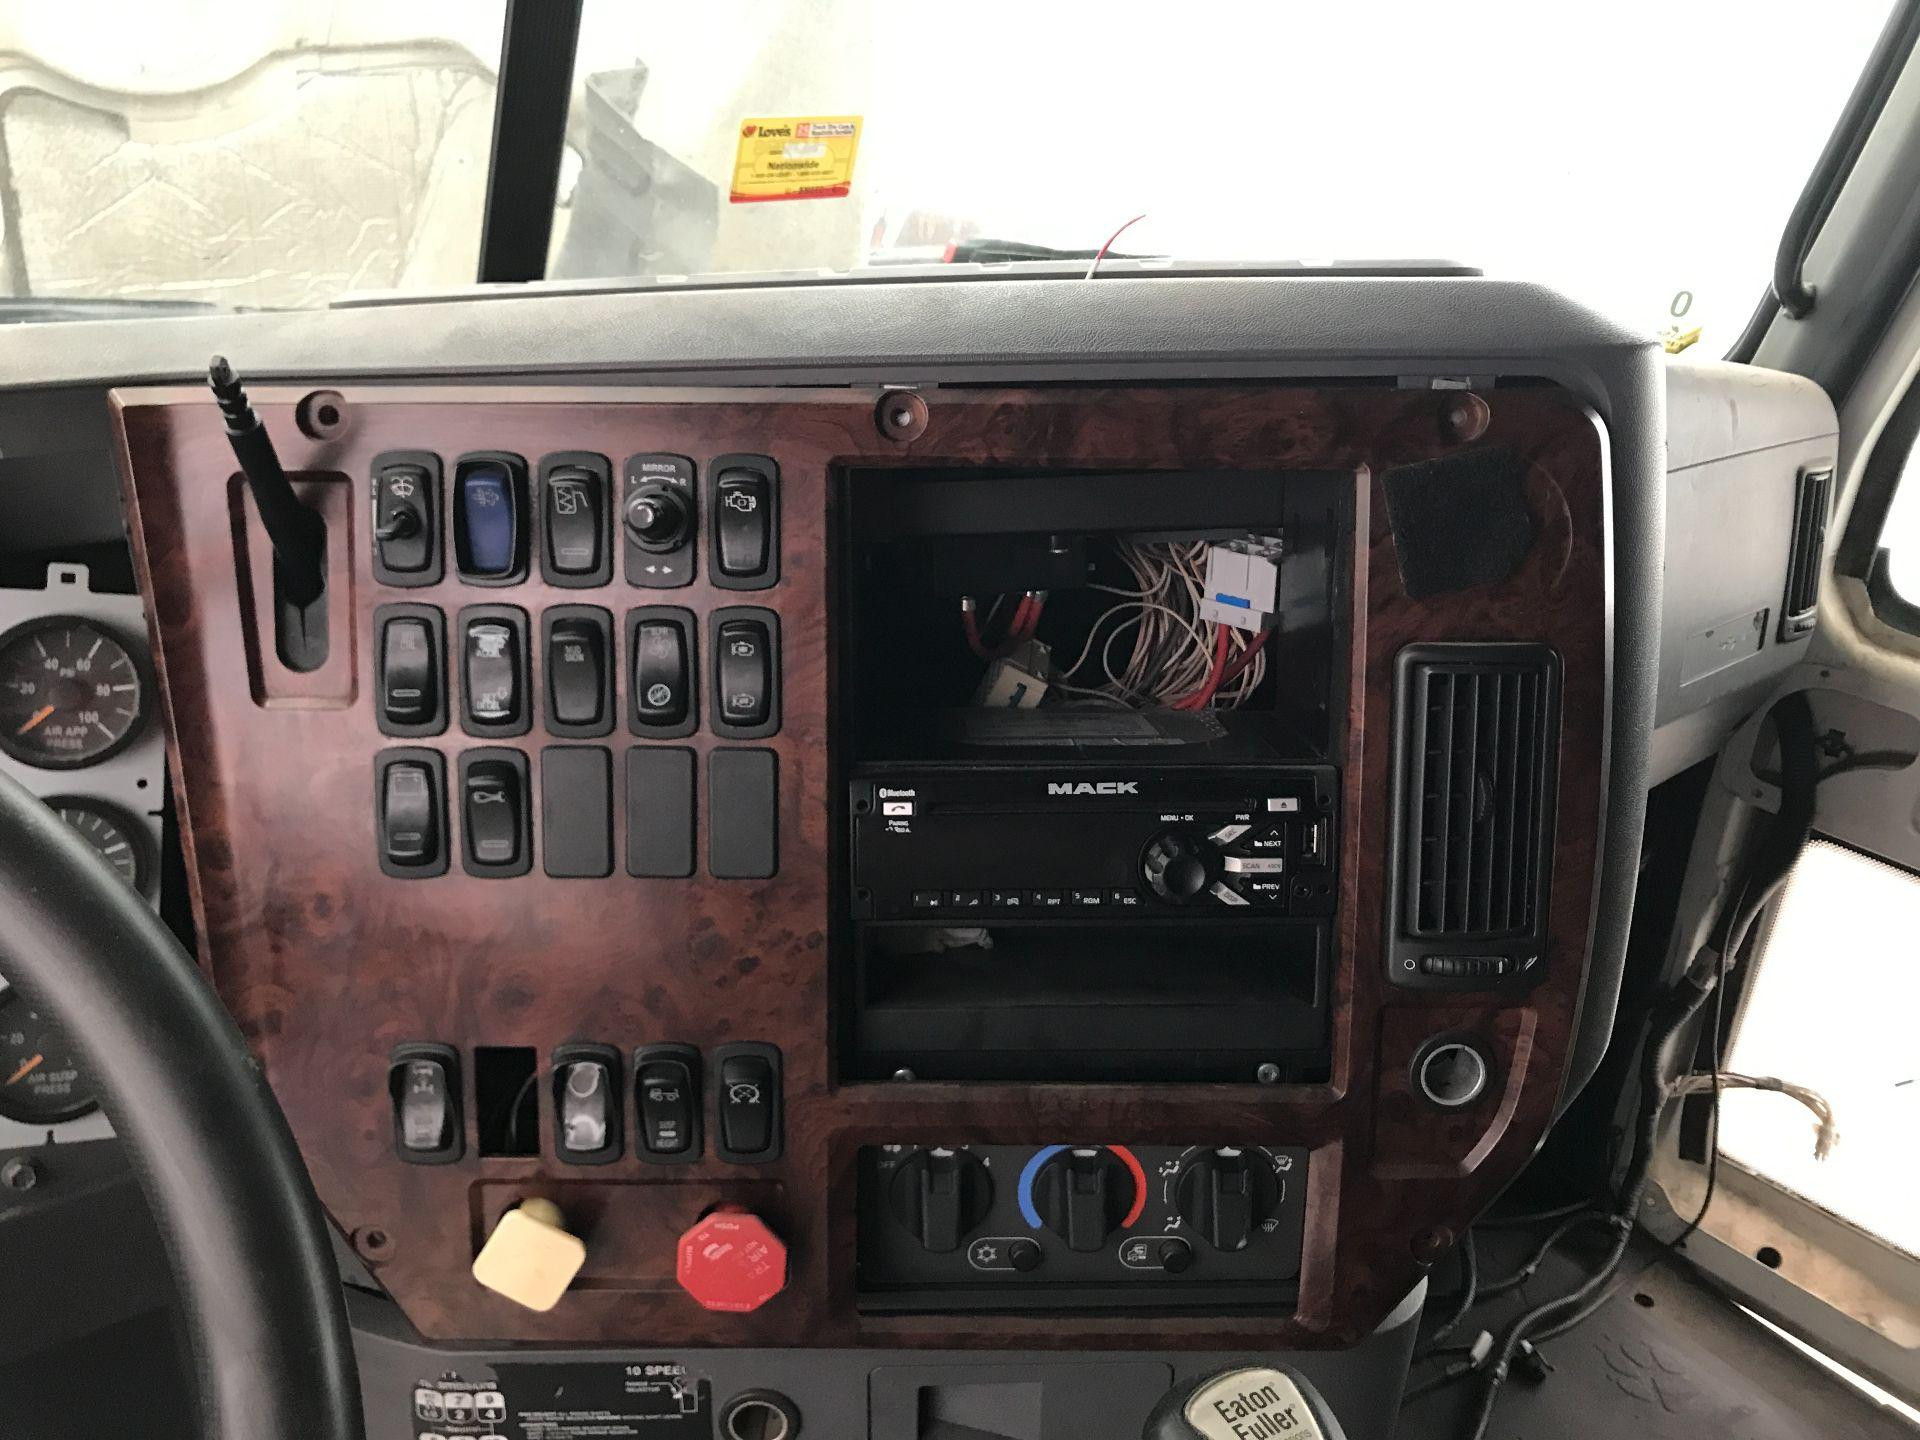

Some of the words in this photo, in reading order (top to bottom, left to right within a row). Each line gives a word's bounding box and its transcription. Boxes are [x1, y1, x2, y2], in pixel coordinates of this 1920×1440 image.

[642, 463, 676, 472] MIRROR
[79, 711, 99, 724] 100
[1047, 781, 1139, 794] MACK
[1234, 813, 1251, 821] PWR
[1263, 840, 1282, 848] NEXT
[1261, 883, 1281, 891] PREV
[625, 1366, 642, 1377] 10
[645, 1366, 688, 1377] SPEE
[1213, 1384, 1280, 1424] Eaton
[1232, 1406, 1299, 1440] Fuller
